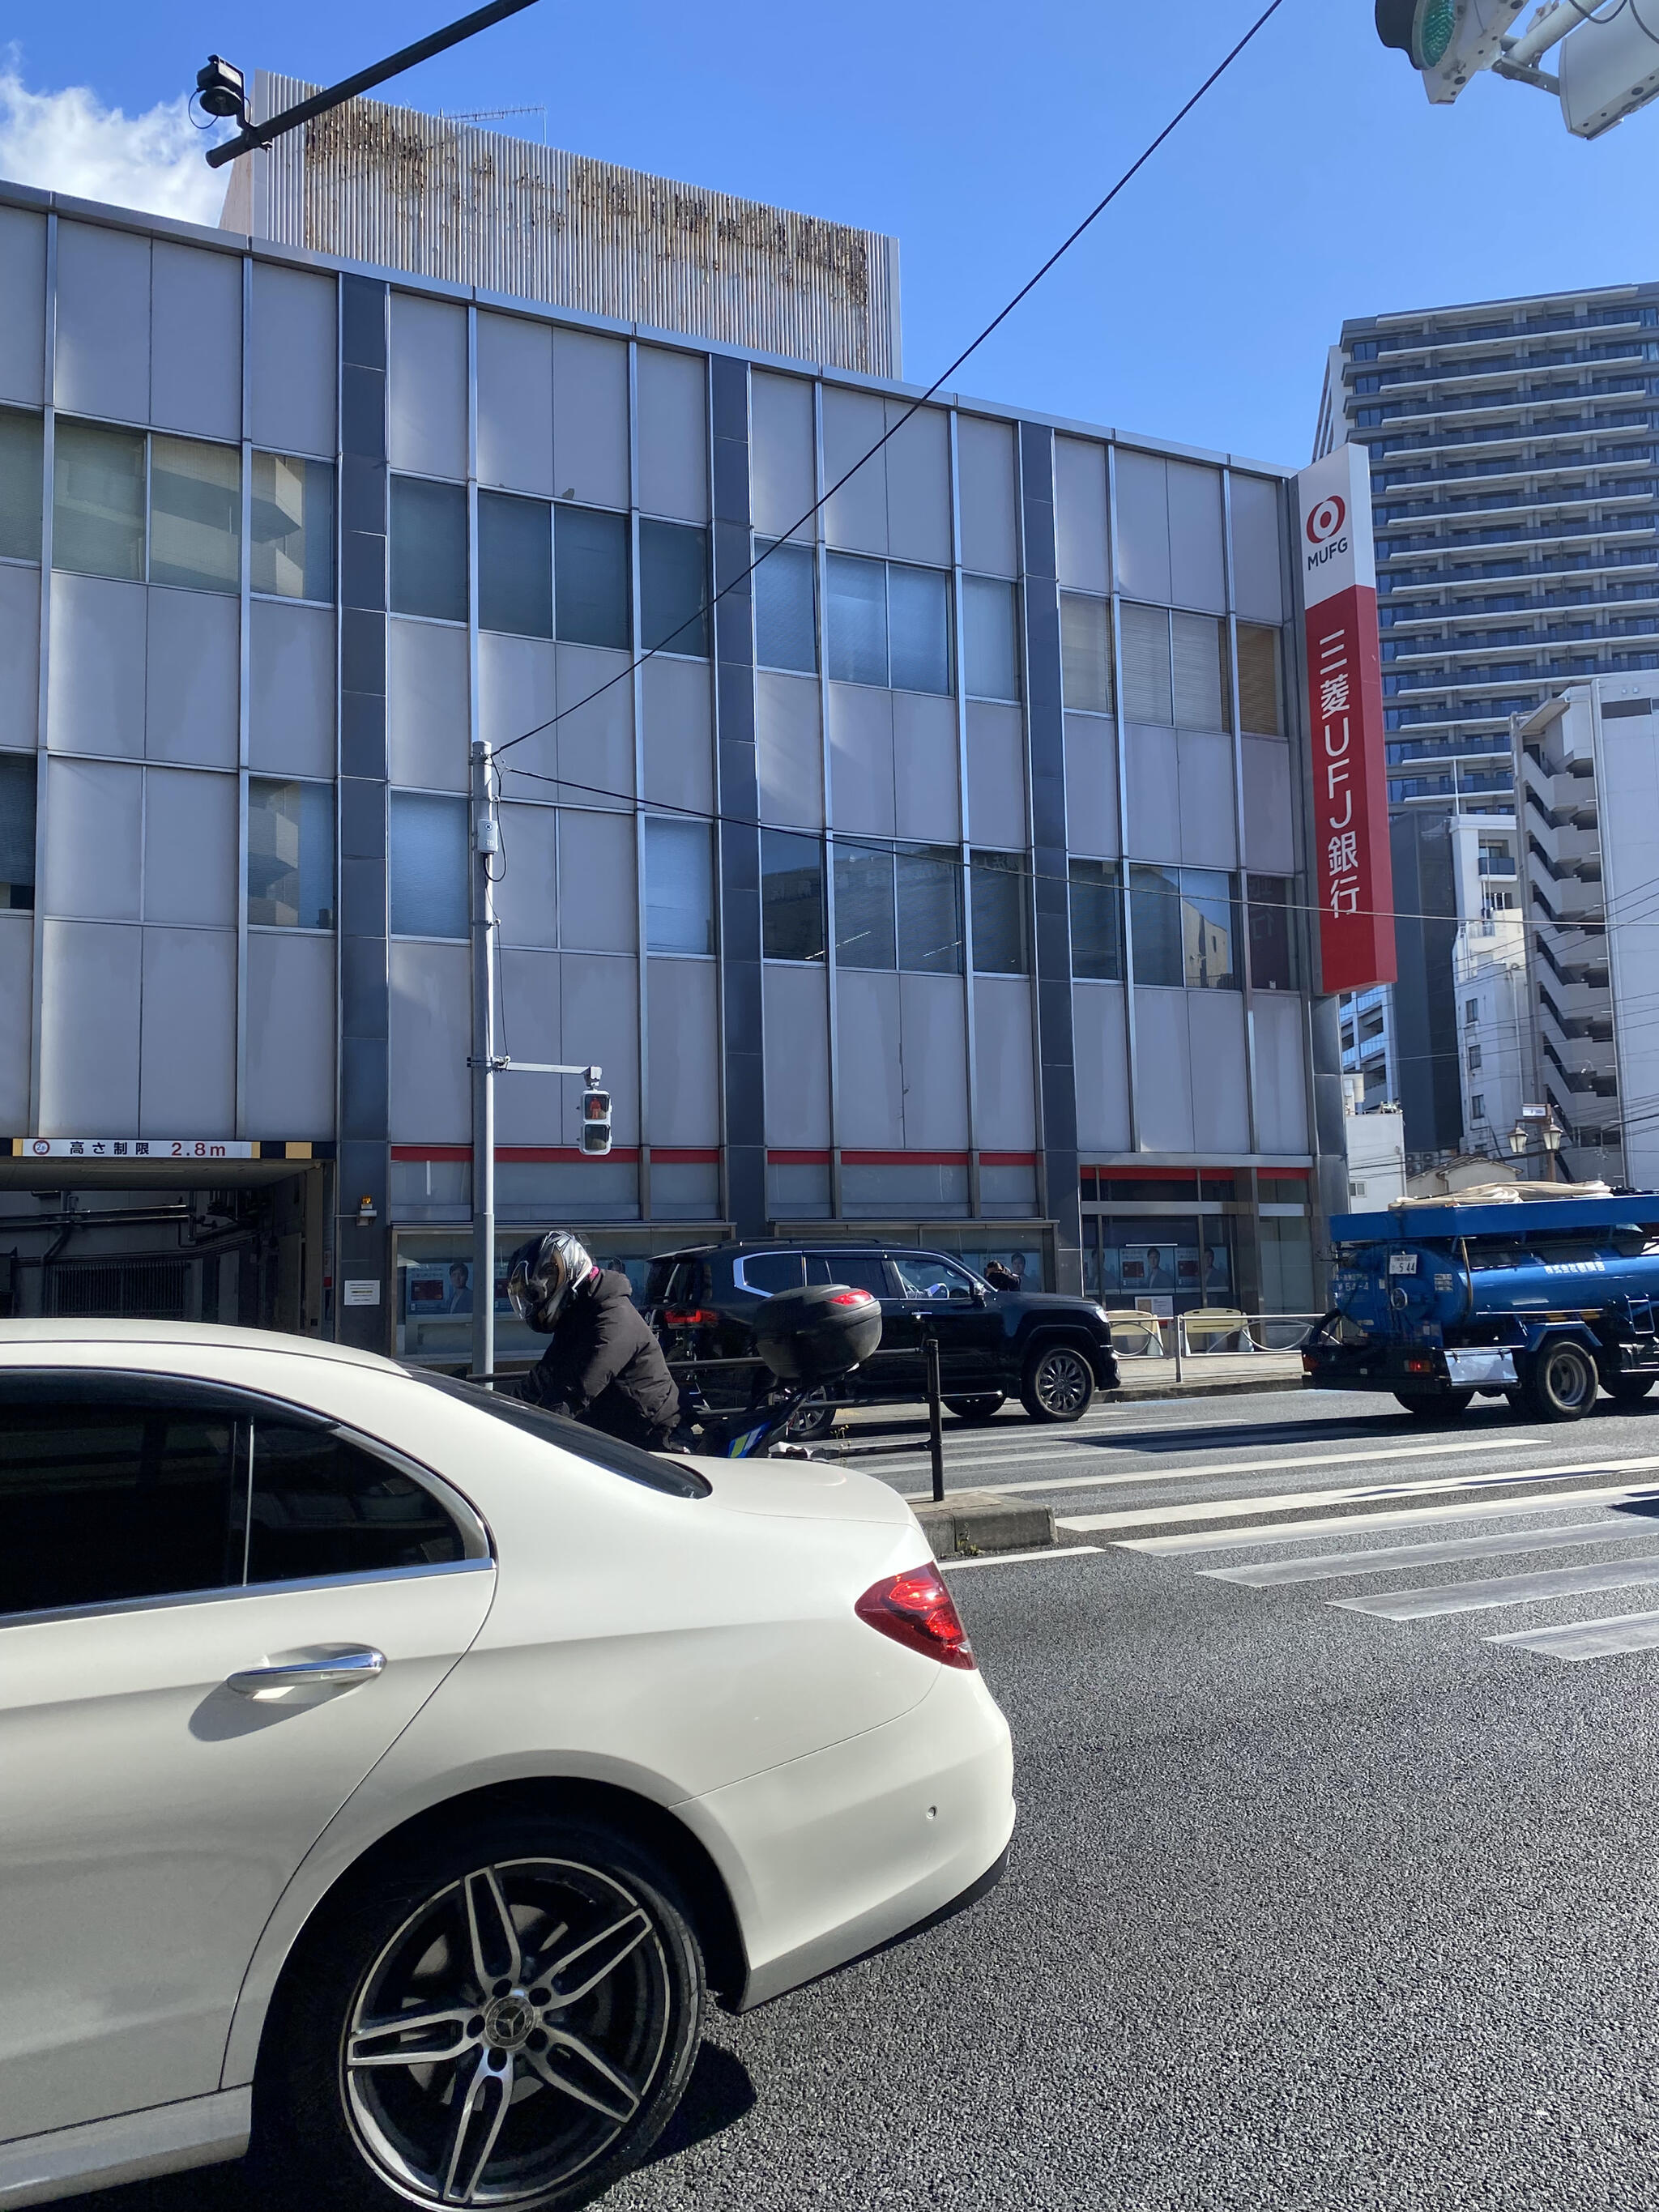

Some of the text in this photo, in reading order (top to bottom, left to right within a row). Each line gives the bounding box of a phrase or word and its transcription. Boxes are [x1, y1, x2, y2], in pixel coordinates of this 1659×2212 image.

[1307, 537, 1348, 571] MUFG
[1320, 629, 1360, 919] 三菱UFJ銀行
[70, 1140, 226, 1157] 高さ制限 2.8m
